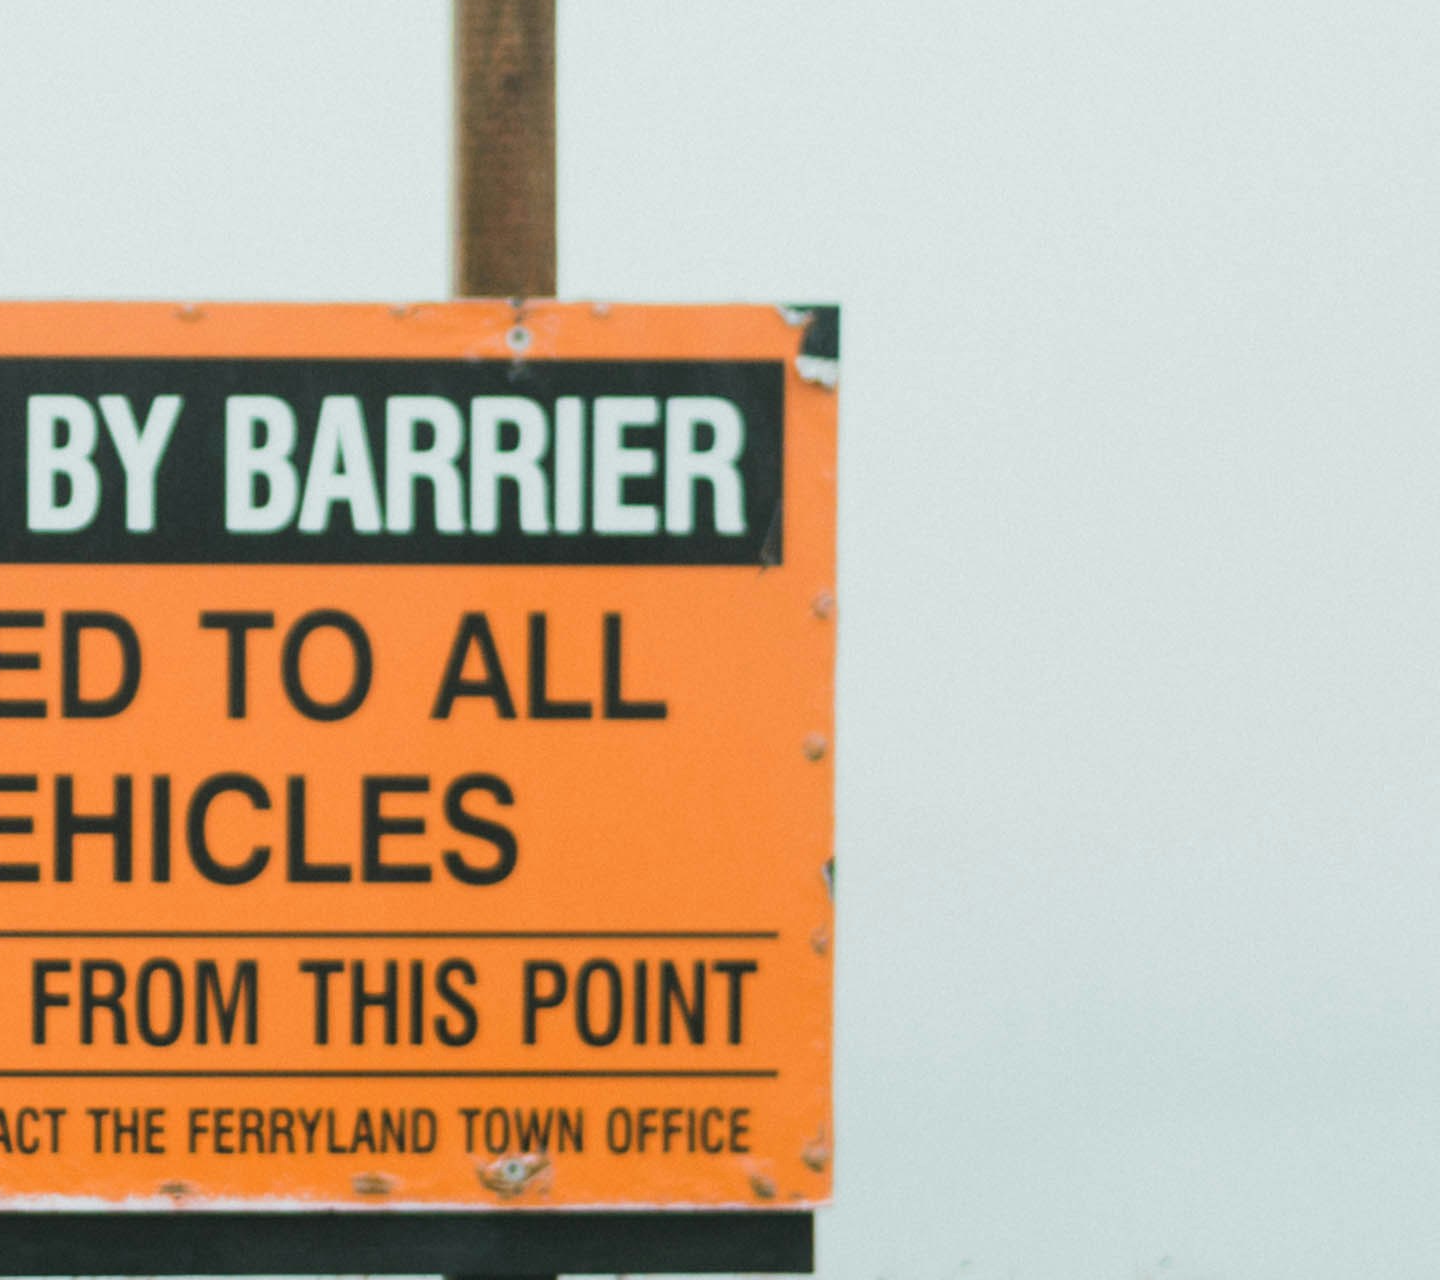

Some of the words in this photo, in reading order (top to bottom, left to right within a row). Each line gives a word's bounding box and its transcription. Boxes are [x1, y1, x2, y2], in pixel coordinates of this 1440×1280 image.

[27, 395, 181, 531] BY
[226, 395, 744, 534] BARRIER
[199, 609, 373, 723] TO
[431, 612, 668, 721] ALL
[32, 957, 258, 1048] FROM
[299, 958, 479, 1048] THIS
[523, 958, 758, 1048] POINT
[88, 1108, 165, 1155] THE
[189, 1108, 437, 1155] FERRYLAND
[461, 1108, 583, 1155] TOWN
[607, 1108, 749, 1155] OFFICE
